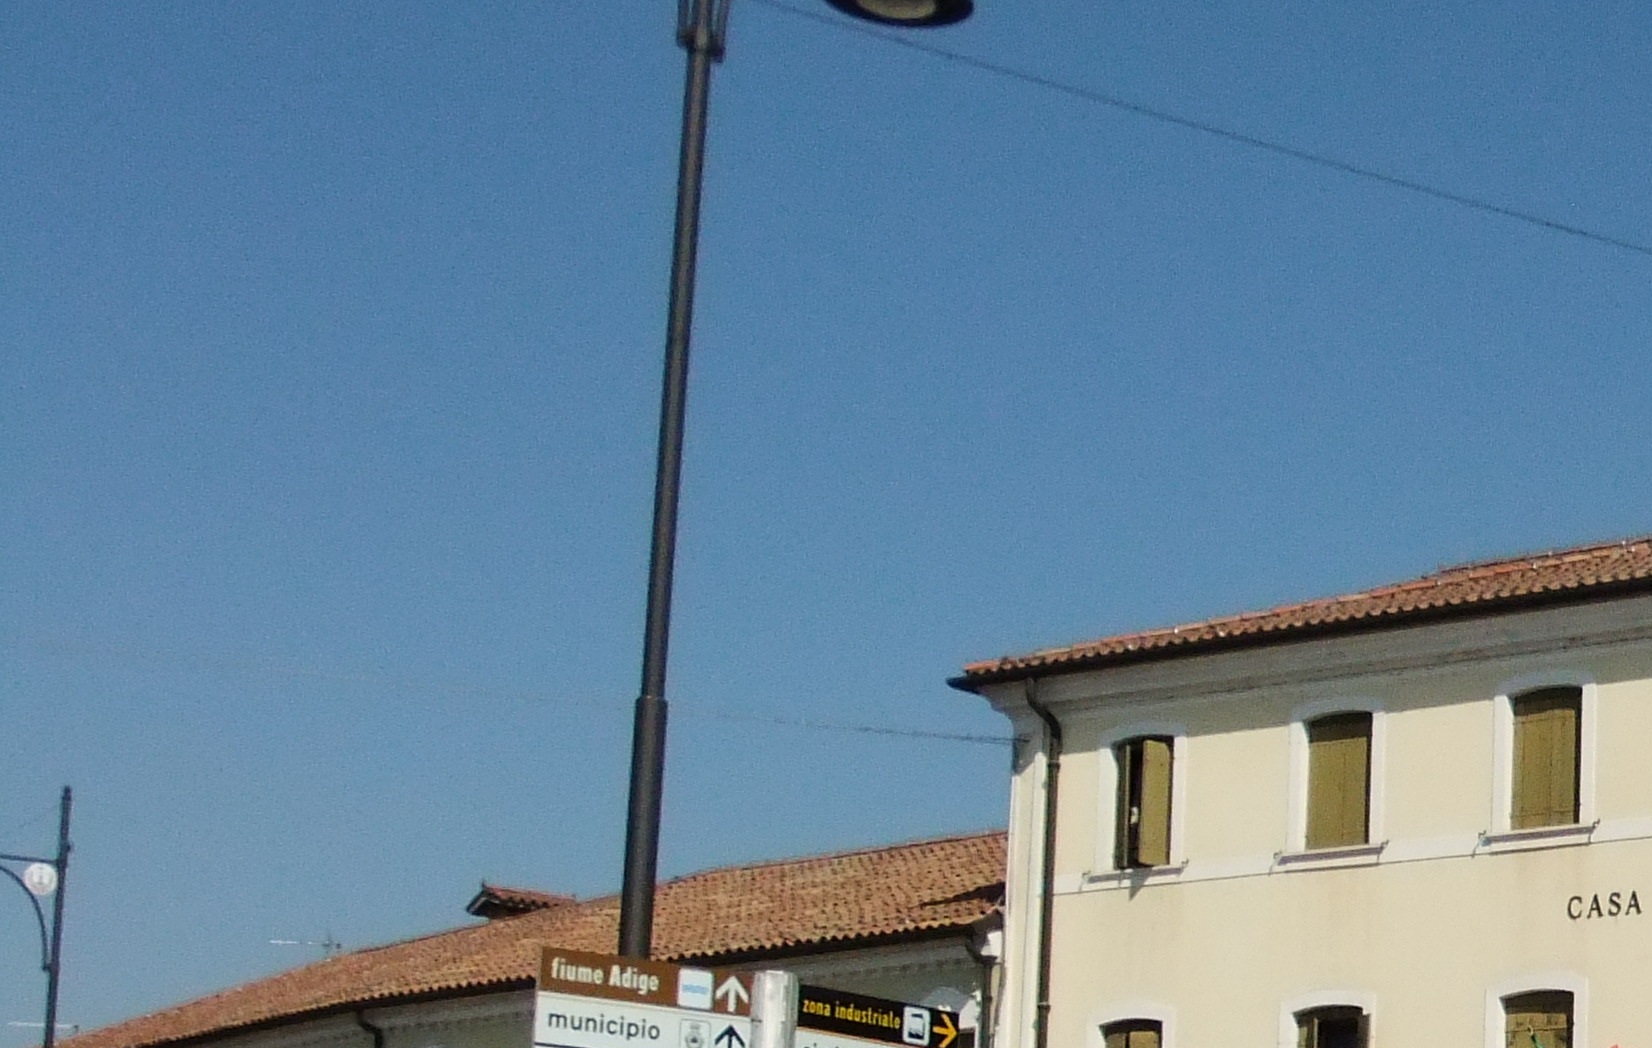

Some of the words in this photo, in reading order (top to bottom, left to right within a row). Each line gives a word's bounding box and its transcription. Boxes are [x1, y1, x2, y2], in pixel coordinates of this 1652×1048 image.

[1565, 889, 1643, 920] CASA
[551, 959, 604, 986] fiume
[608, 964, 660, 995] Adige
[547, 1010, 661, 1041] municipio
[802, 999, 832, 1016] zona
[834, 1001, 901, 1030] industriale
